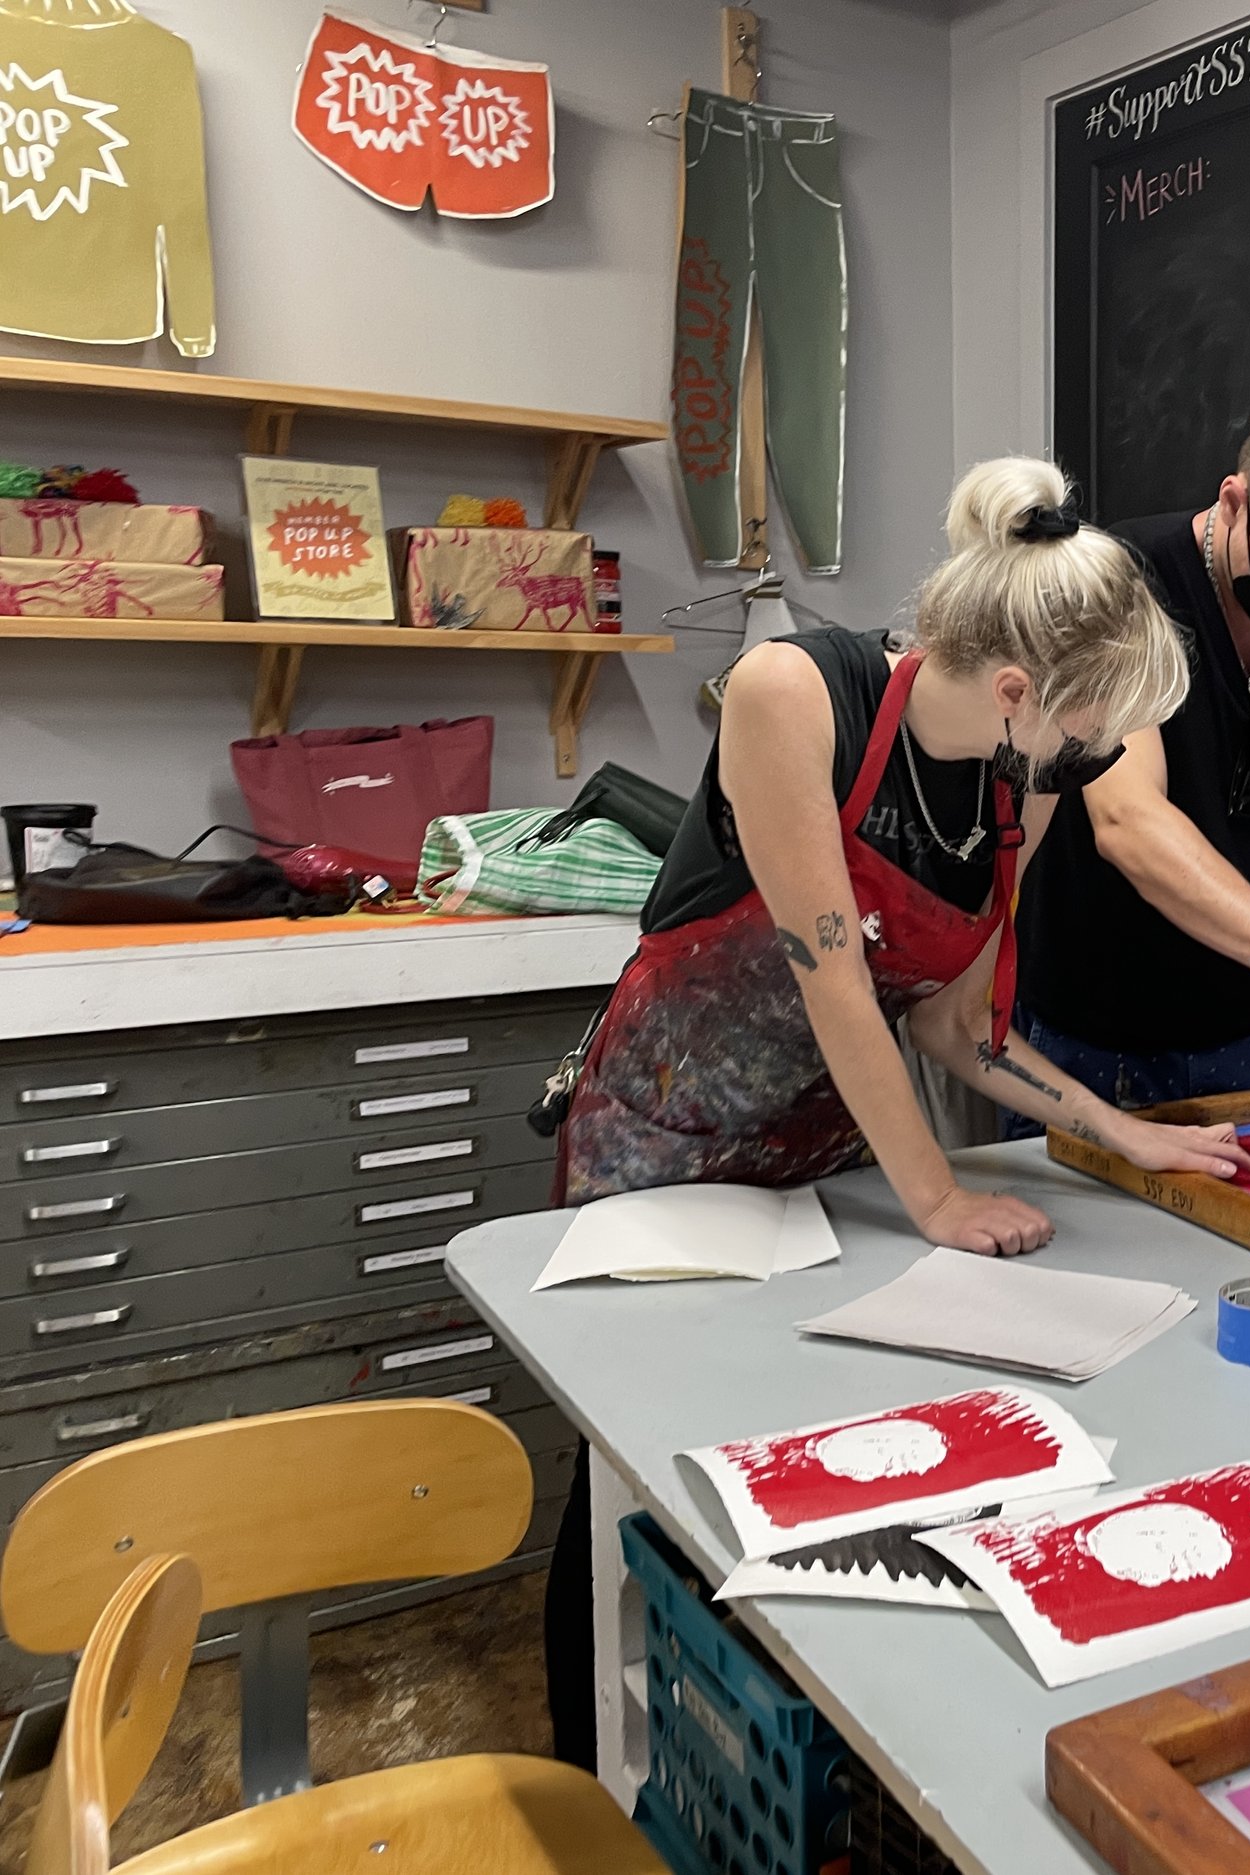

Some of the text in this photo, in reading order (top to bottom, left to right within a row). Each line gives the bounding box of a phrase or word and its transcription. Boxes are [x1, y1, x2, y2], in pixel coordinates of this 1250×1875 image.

[348, 72, 412, 125] POP
[0, 101, 71, 147] POP
[463, 105, 510, 146] UP
[3, 144, 55, 182] UP
[1121, 157, 1211, 221] MERCH:
[682, 258, 718, 454] POP UP
[283, 526, 354, 545] POP UP
[292, 542, 355, 562] STORE
